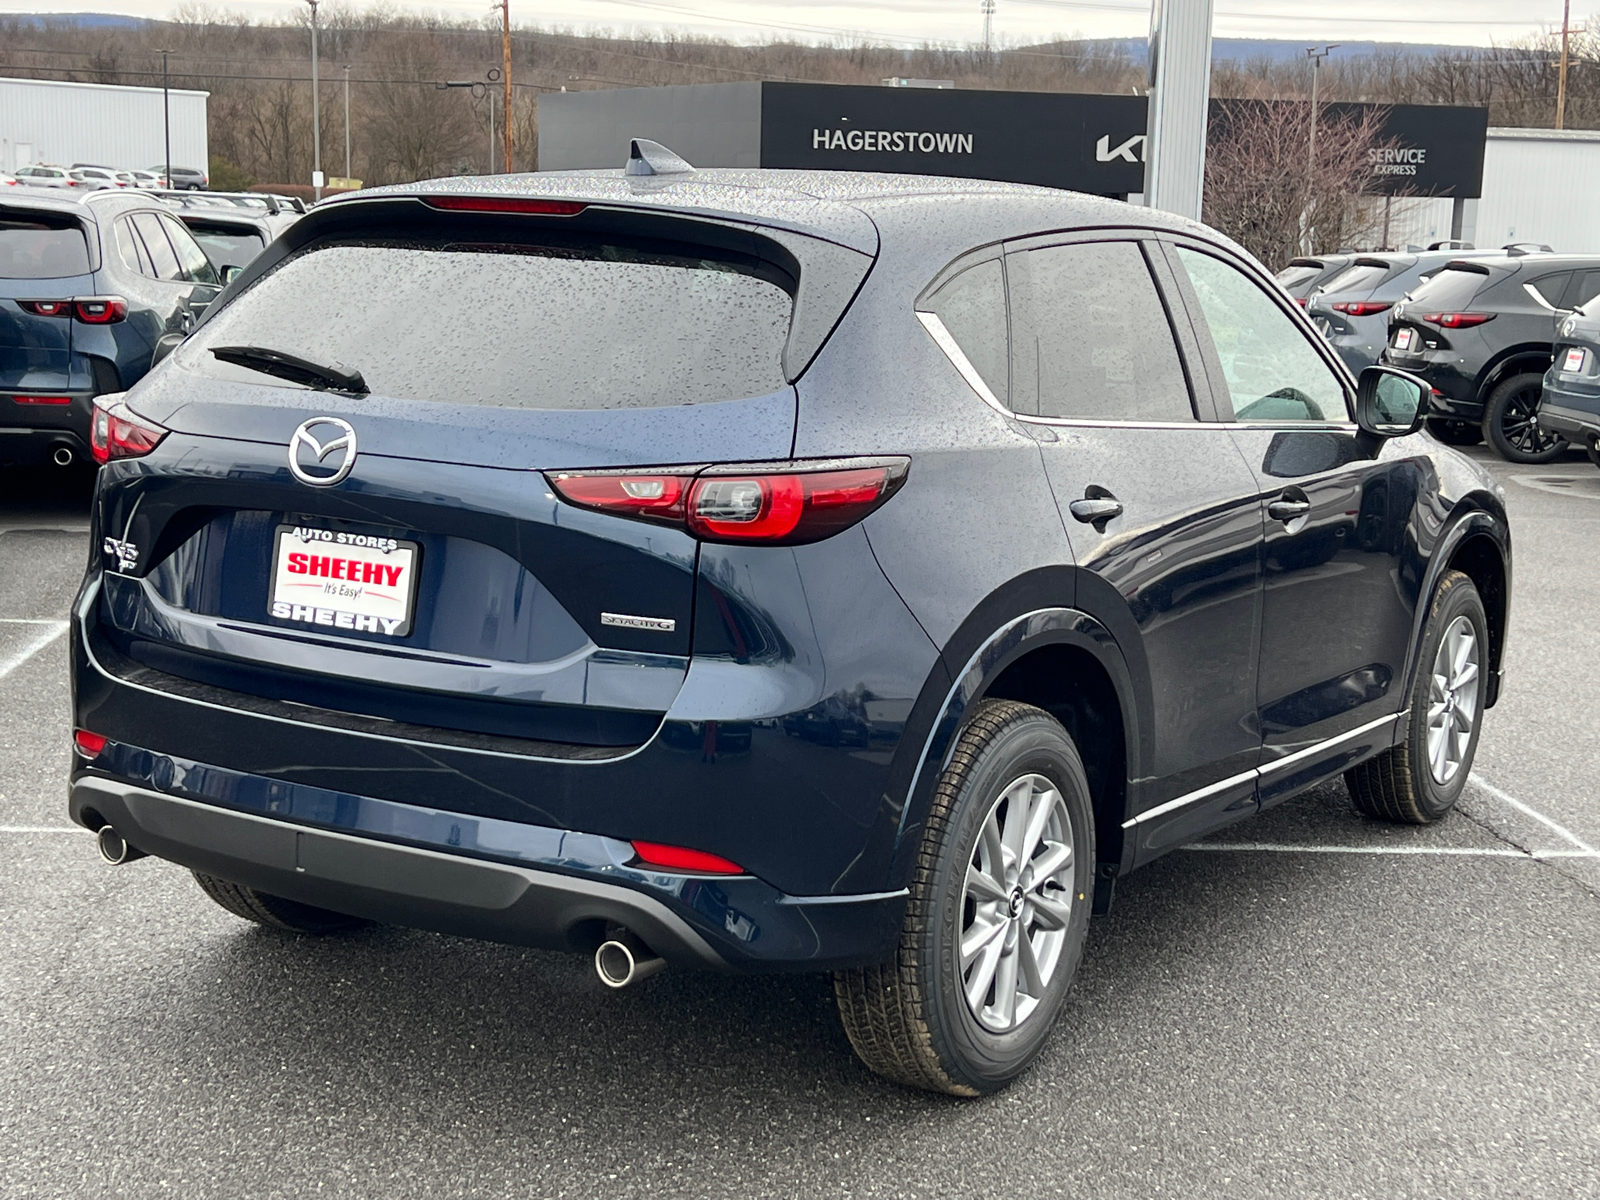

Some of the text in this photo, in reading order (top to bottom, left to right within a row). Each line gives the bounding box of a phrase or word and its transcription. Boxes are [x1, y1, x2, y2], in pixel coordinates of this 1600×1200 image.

[812, 128, 973, 154] HAGERSTOWN
[1368, 148, 1426, 164] SERVICE
[1375, 164, 1417, 176] EXPRESS
[292, 526, 398, 550] AUTO STORES
[287, 552, 404, 588] SHEEHY
[324, 581, 363, 601] It's Easy!
[272, 601, 403, 636] SHEEHY
